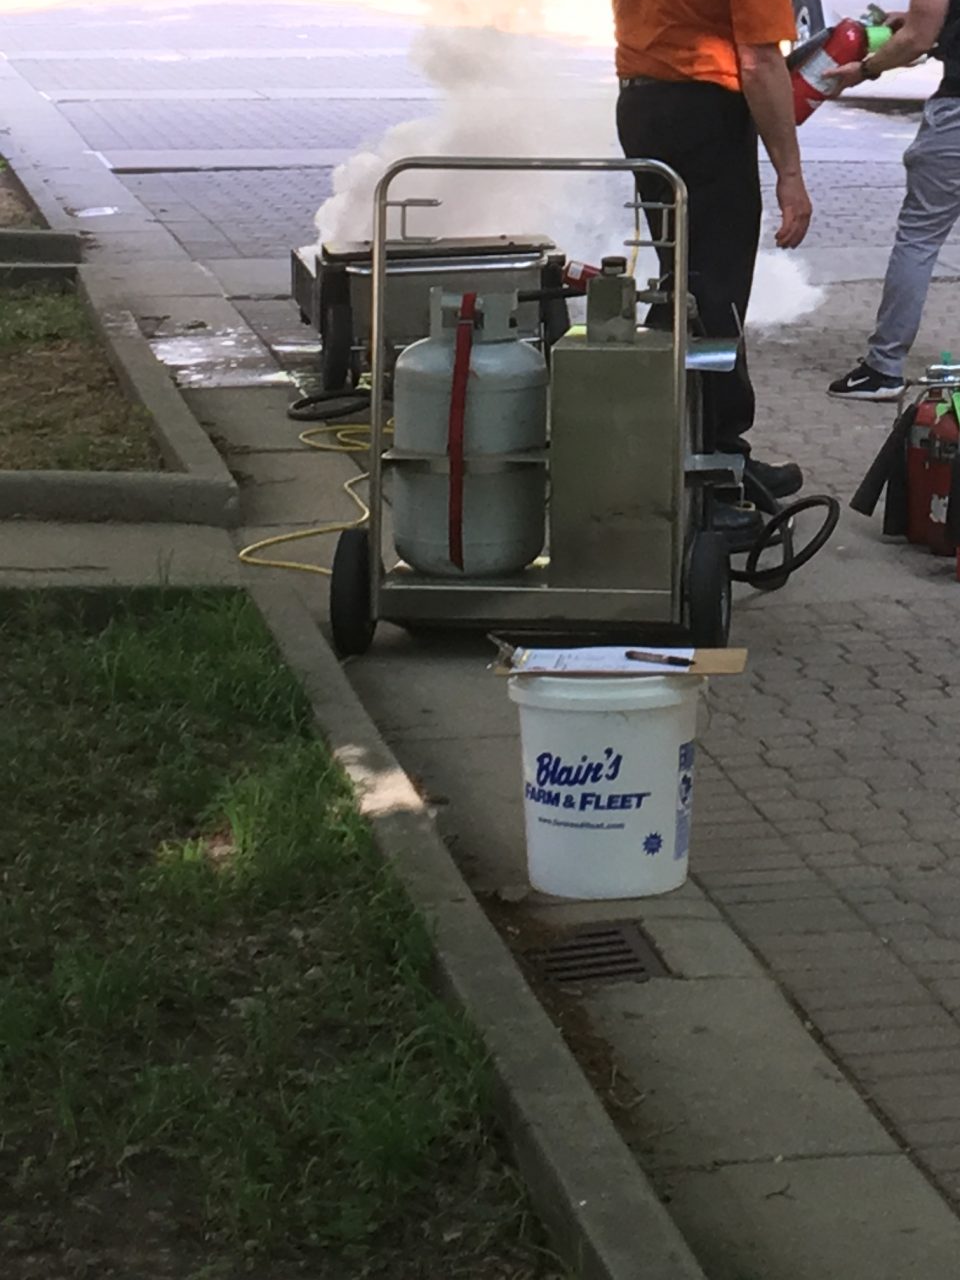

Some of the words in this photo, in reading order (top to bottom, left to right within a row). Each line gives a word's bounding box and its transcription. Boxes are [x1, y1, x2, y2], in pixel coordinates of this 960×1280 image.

[537, 748, 622, 786] Blain's
[526, 783, 560, 807] FARM
[563, 794, 576, 808] &
[579, 792, 651, 811] FLEET
